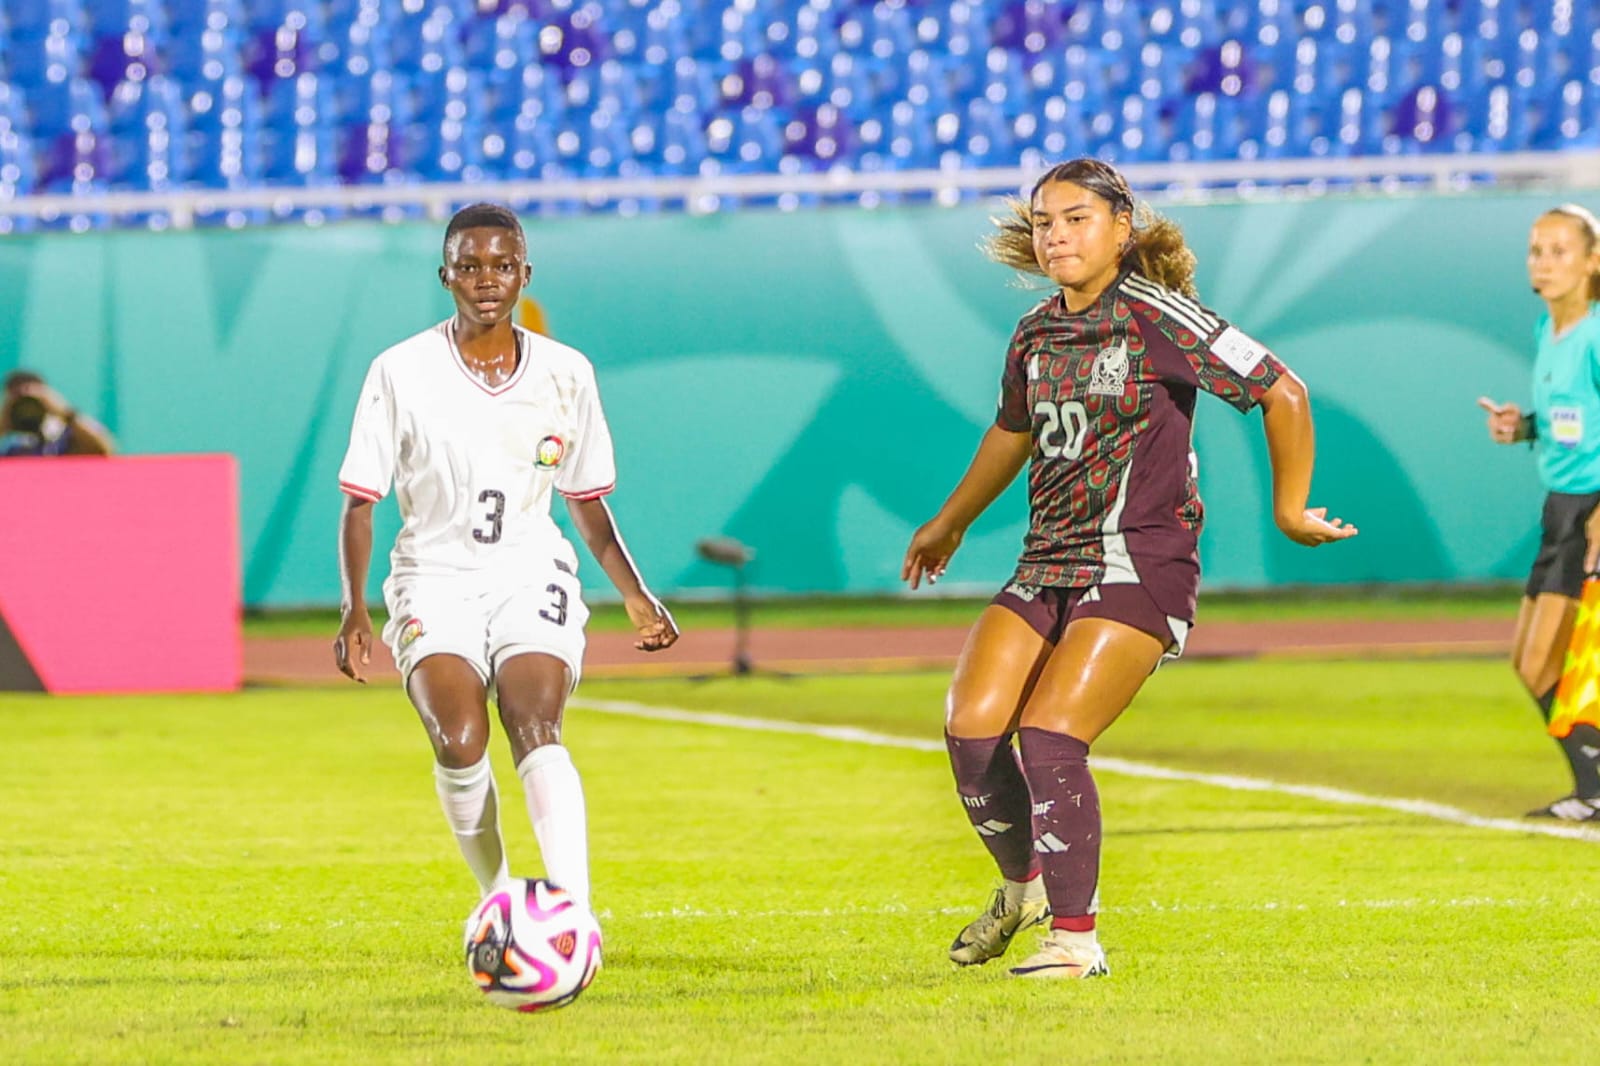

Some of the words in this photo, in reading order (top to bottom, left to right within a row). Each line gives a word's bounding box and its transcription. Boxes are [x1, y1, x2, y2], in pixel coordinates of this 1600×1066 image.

[1035, 401, 1088, 460] 20
[472, 489, 506, 544] 3
[538, 583, 569, 626] 3
